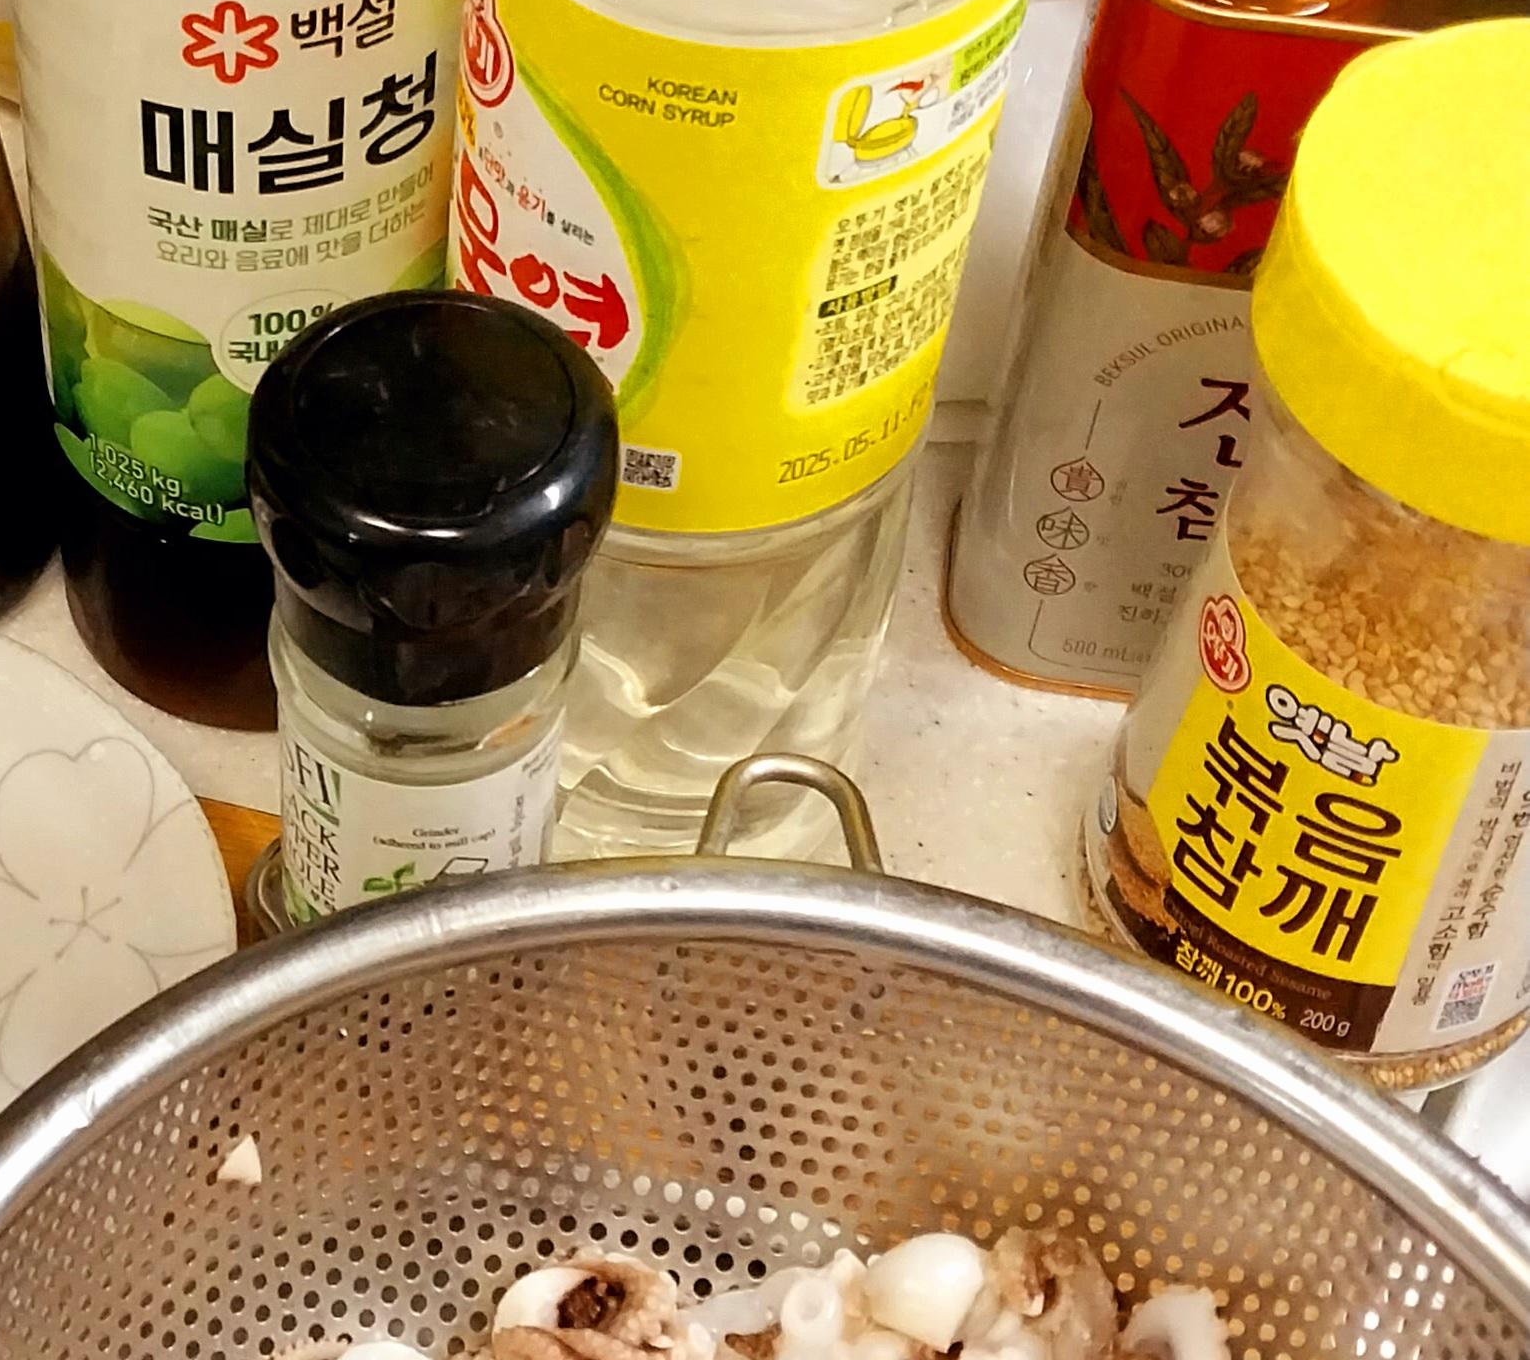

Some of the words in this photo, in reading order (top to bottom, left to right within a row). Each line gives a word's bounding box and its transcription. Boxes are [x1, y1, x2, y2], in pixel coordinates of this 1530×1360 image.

[597, 83, 657, 117] CORN
[661, 102, 737, 129] SYRUP
[646, 75, 739, 107] KOREAN
[140, 50, 438, 196] 매실청
[147, 204, 204, 240] 국산
[210, 216, 294, 243] 매실로
[301, 197, 372, 238] 제대로
[155, 240, 231, 271] 요리와
[234, 244, 311, 273] 음료에
[315, 229, 363, 266] 맛을
[367, 199, 427, 246] 더하는
[1092, 344, 1157, 388] BEKSUL
[150, 467, 182, 498] kg
[160, 493, 225, 526] kcal)
[1039, 513, 1085, 549] 味
[1027, 557, 1069, 594] 香
[1061, 638, 1098, 659] 500
[1264, 683, 1400, 788] 옛날
[1203, 713, 1404, 887] 볶음
[411, 826, 461, 839] Grinder
[428, 841, 443, 851] to
[1171, 791, 1380, 964] 참깨
[1173, 941, 1224, 988] 참깨
[1225, 972, 1287, 1021] 100%
[1299, 1007, 1336, 1032] 200
[1336, 1017, 1351, 1038] g
